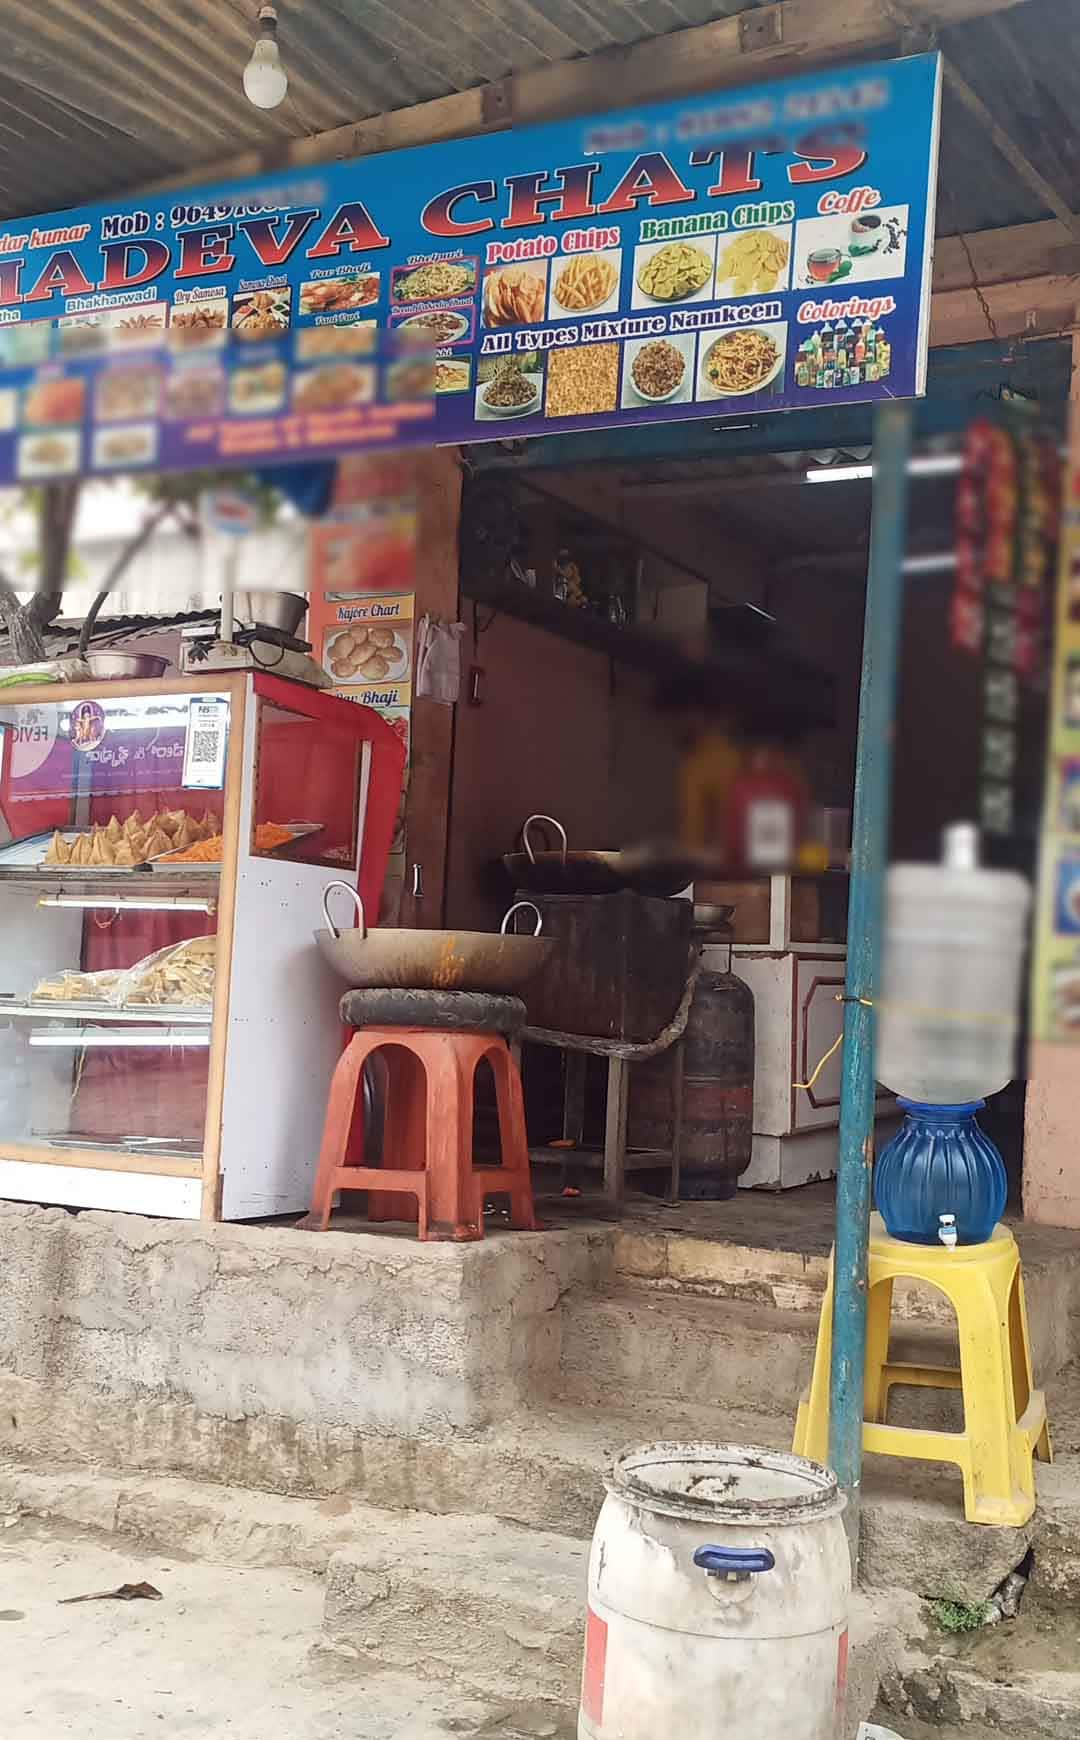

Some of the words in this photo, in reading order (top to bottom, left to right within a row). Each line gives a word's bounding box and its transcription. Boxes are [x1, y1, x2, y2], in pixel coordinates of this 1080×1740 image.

[818, 186, 880, 213] Coffe
[102, 211, 149, 240] Mob
[640, 212, 726, 240] Banana
[733, 200, 795, 228] Chips
[31, 224, 90, 248] kumar
[486, 236, 556, 264] Potato
[563, 226, 620, 252] Chips
[66, 287, 156, 311] Bhakharwadi
[798, 296, 896, 324] Colorings
[482, 332, 510, 354] All
[516, 327, 577, 350] Types
[582, 314, 666, 342] Mixture
[671, 301, 782, 329] Namkeen
[371, 603, 400, 617] Chart
[361, 690, 399, 706] Bhaji
